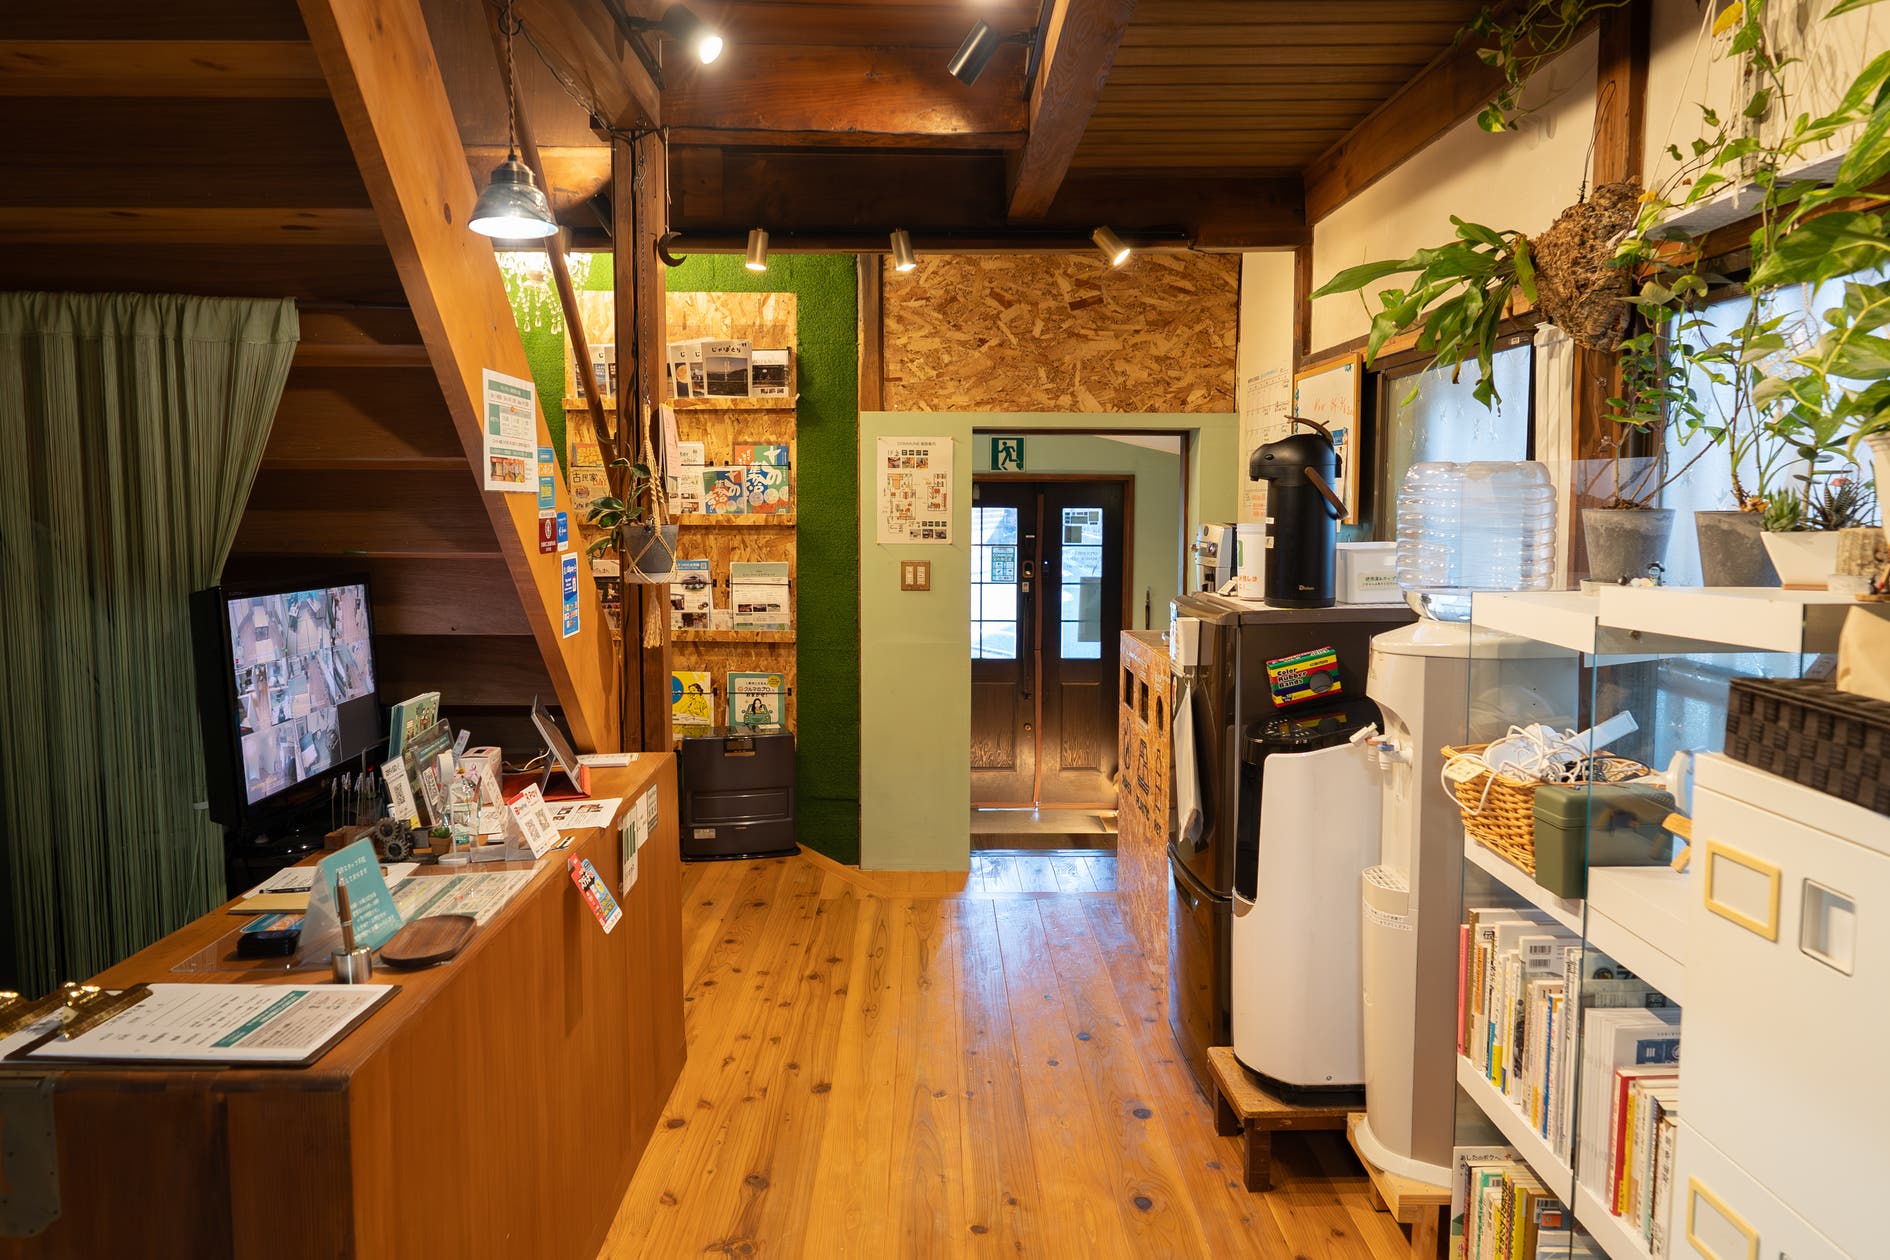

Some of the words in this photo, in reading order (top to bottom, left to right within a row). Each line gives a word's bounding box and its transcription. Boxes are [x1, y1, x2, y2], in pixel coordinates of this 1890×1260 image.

[1277, 667, 1297, 676] Color
[1278, 671, 1307, 682] Rubber
[1279, 679, 1303, 689] Bands
